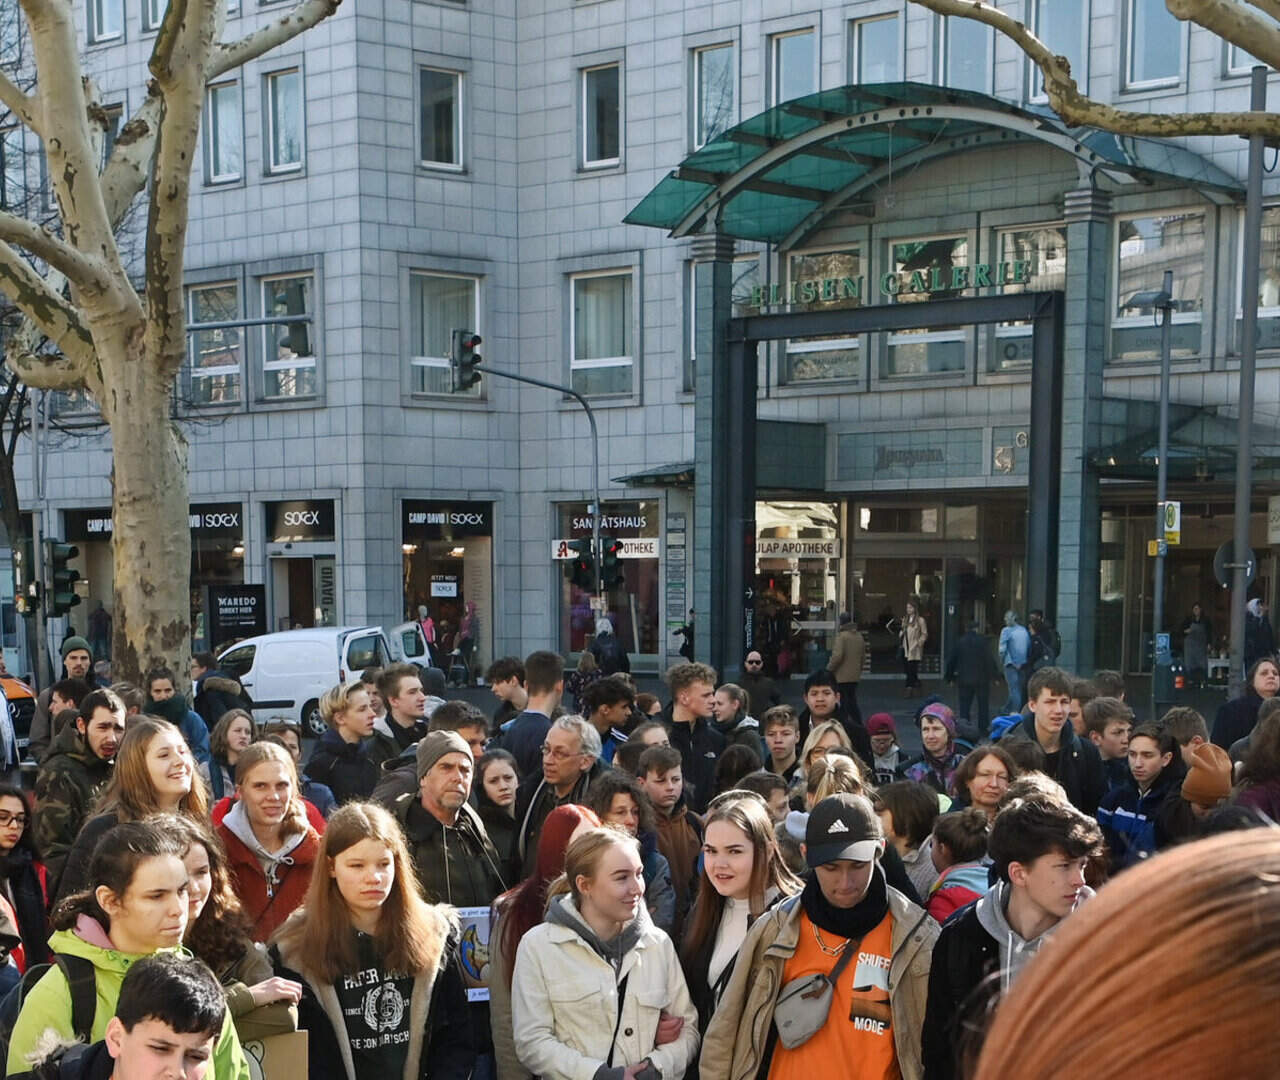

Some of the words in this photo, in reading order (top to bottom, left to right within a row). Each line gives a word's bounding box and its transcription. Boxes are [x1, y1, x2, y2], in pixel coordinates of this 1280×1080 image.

[751, 276, 863, 307] ELISEN
[880, 260, 1031, 296] GALERIE
[781, 542, 833, 554] APOTHEKE
[218, 597, 257, 606] MAREDO
[854, 1016, 884, 1036] MODE
